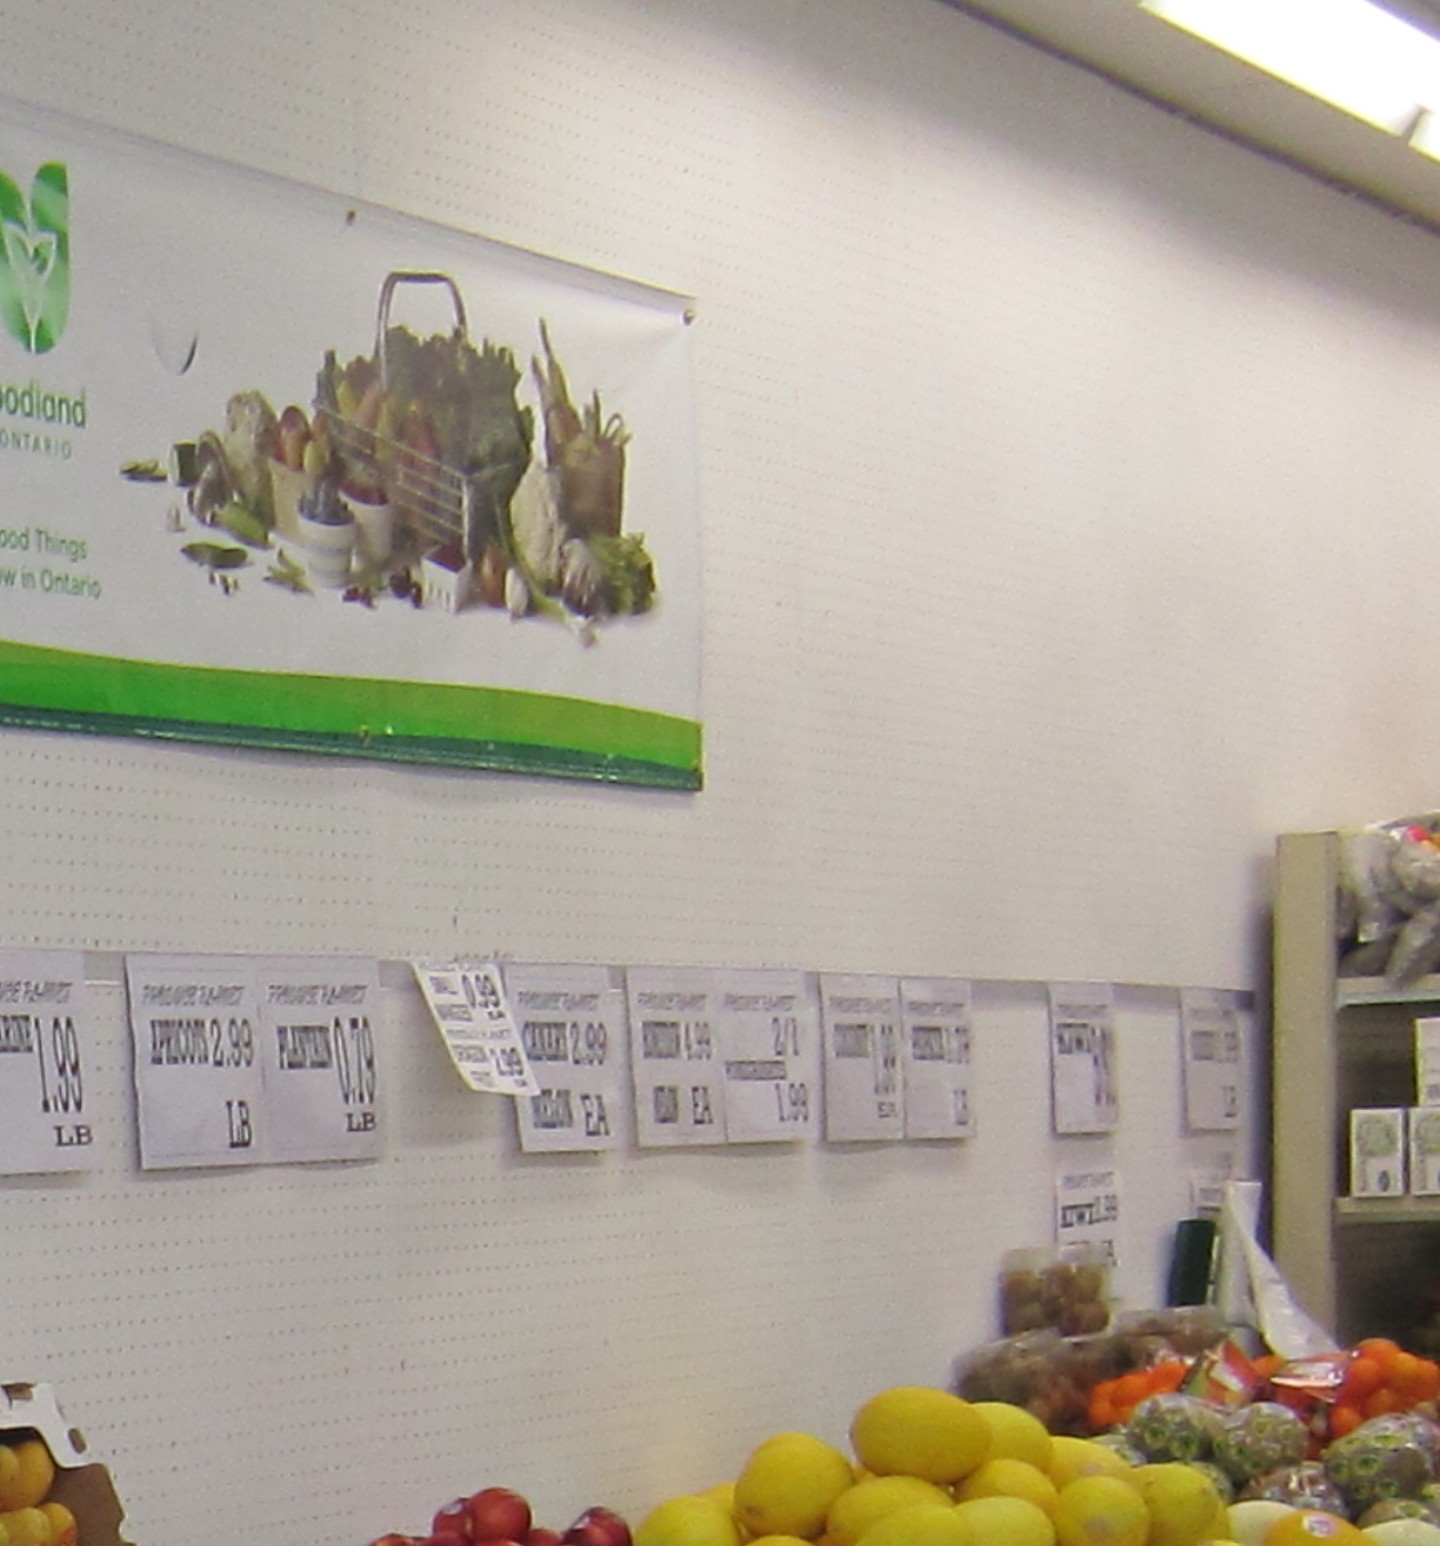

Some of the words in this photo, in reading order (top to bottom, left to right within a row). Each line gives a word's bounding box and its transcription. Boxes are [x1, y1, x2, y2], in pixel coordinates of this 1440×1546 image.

[35, 526, 88, 563] Things
[21, 564, 35, 590] in
[41, 567, 102, 601] Ontario
[209, 1017, 253, 1068] 2.99
[34, 1016, 82, 1113] 1.99
[226, 1100, 252, 1149] LB
[346, 1111, 376, 1132] LB
[580, 1093, 610, 1136] EA
[53, 1124, 93, 1147] LB
